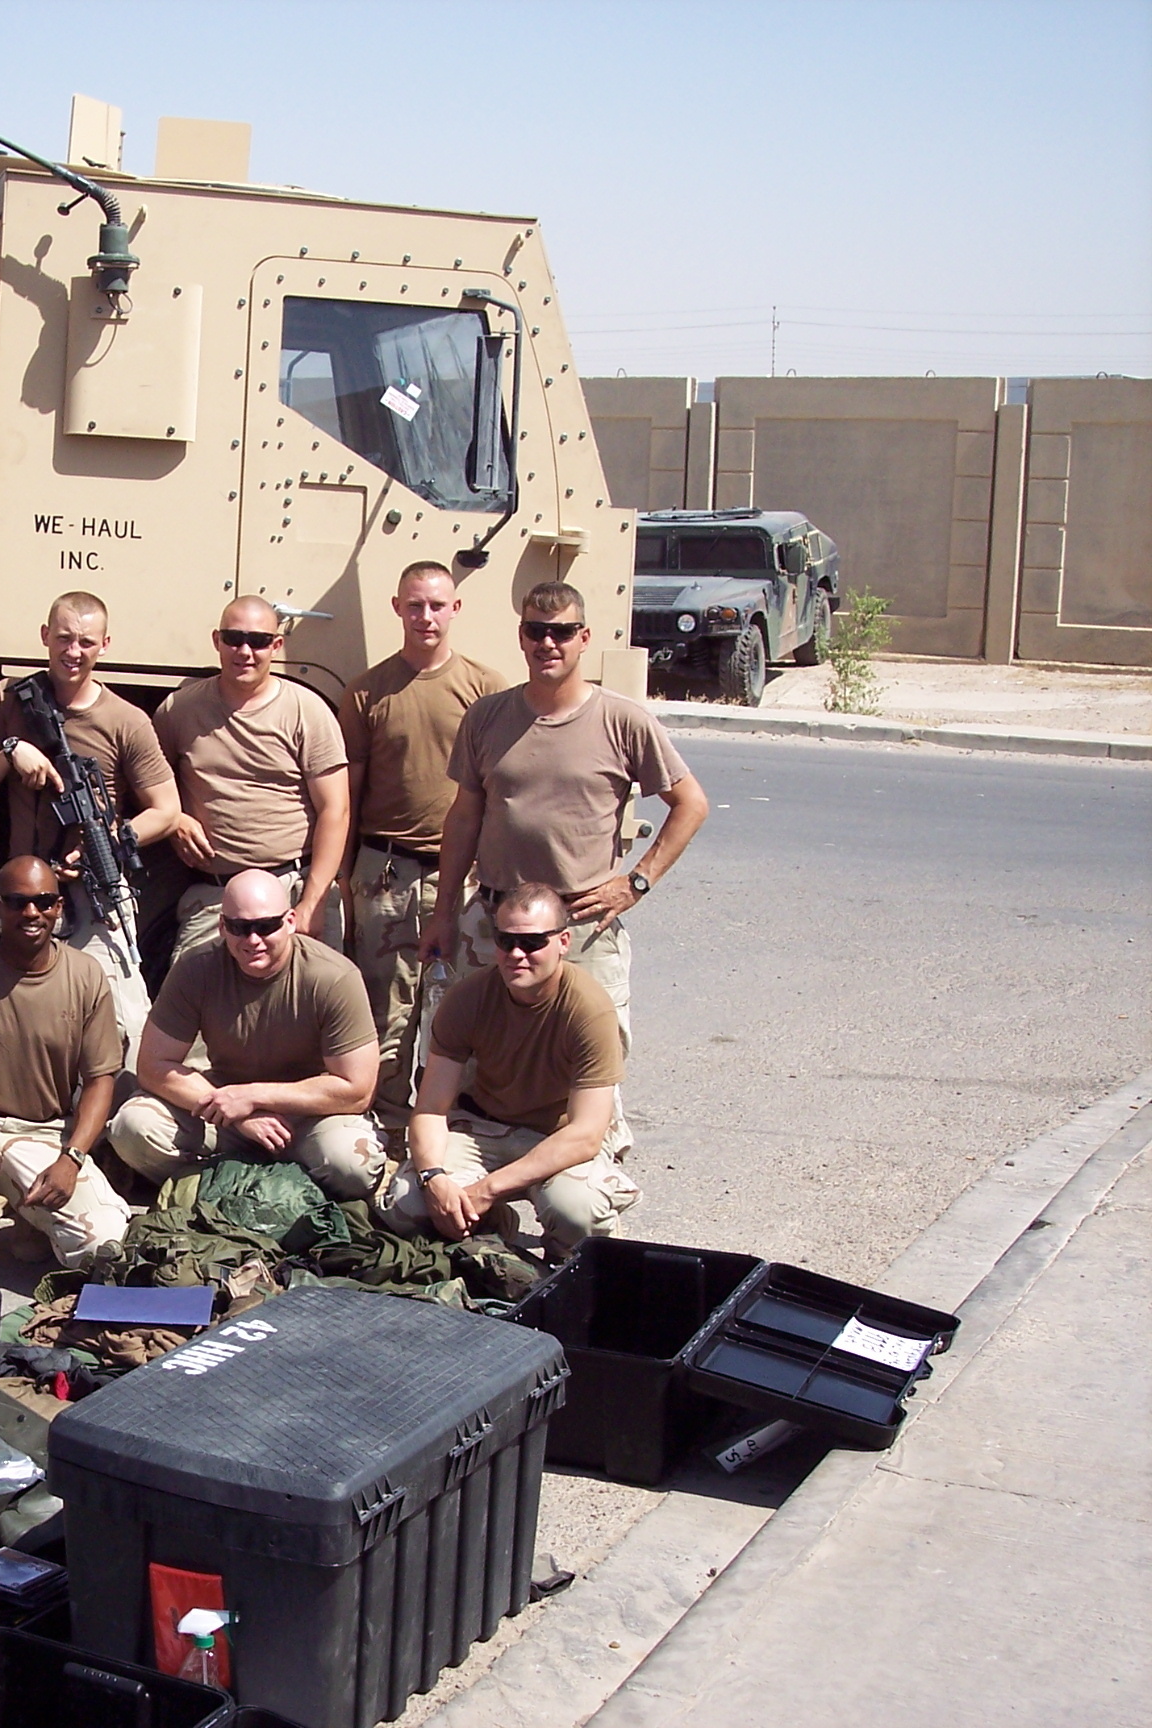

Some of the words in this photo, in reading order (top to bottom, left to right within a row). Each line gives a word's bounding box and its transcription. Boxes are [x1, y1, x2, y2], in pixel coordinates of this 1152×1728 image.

[60, 551, 104, 571] INC.
[219, 1319, 278, 1341] 42
[162, 1340, 246, 1375] HHC
